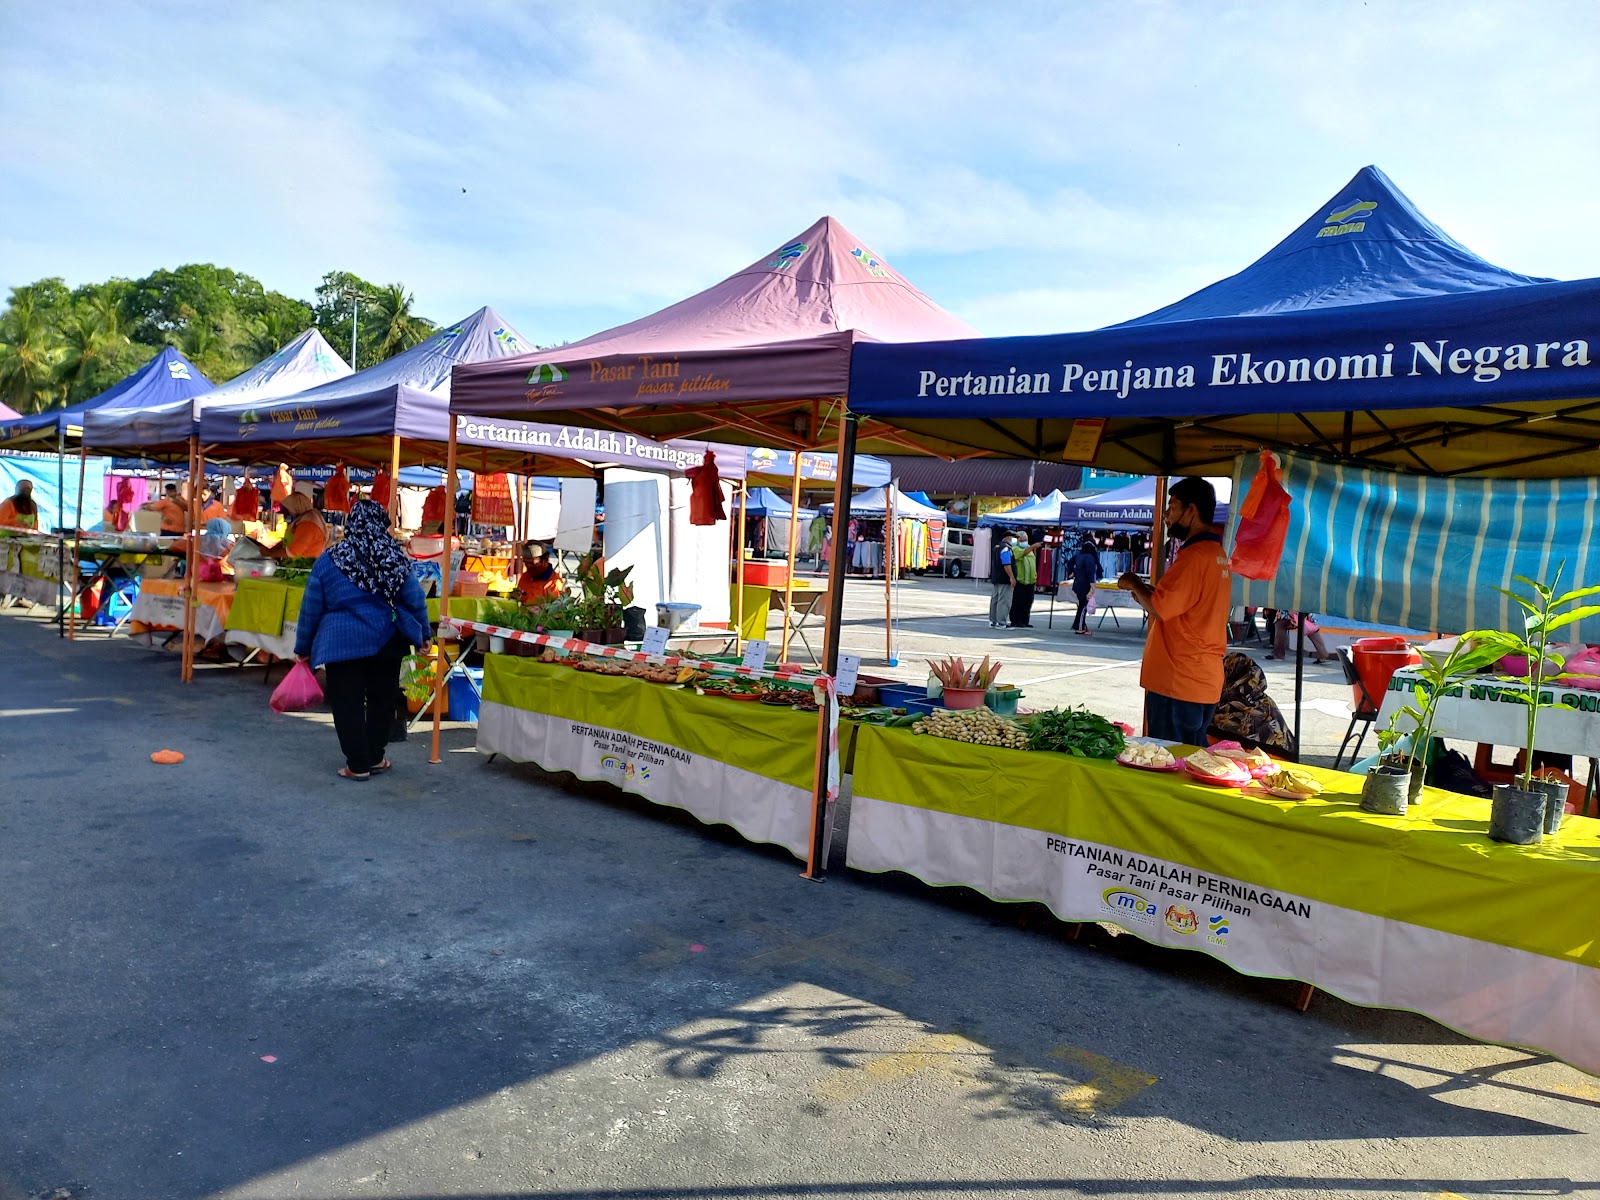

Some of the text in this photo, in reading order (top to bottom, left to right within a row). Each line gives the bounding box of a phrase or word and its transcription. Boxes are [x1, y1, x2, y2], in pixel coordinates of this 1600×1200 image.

[1315, 222, 1366, 239] FAMA
[590, 355, 680, 383] Pasar Tani
[917, 338, 1591, 399] Pertanian Penjana Ekonomi Negara
[635, 372, 731, 399] pasar pilihan
[270, 404, 318, 424] Pasar Tani
[455, 415, 705, 470] Pertanian Adalah Perniagaa
[788, 452, 833, 470] Psar Tani
[1078, 508, 1153, 519] Pertanian Adalah
[1388, 674, 1463, 699] MSLI
[1470, 683, 1554, 706] DWAN
[571, 724, 610, 741] PERTANIAN
[636, 738, 692, 765] PERNIAGAAN
[593, 740, 610, 751] Pasar
[610, 743, 626, 755] Tani
[637, 752, 666, 767] Pilihan
[605, 758, 627, 770] moa
[1046, 837, 1312, 919] PERTANIAN ADALAH PERNIAGAAN
[1086, 862, 1251, 918] Pasar Tani Pasar Pilihan
[1116, 893, 1157, 917] moa
[1206, 934, 1229, 948] FAMA
